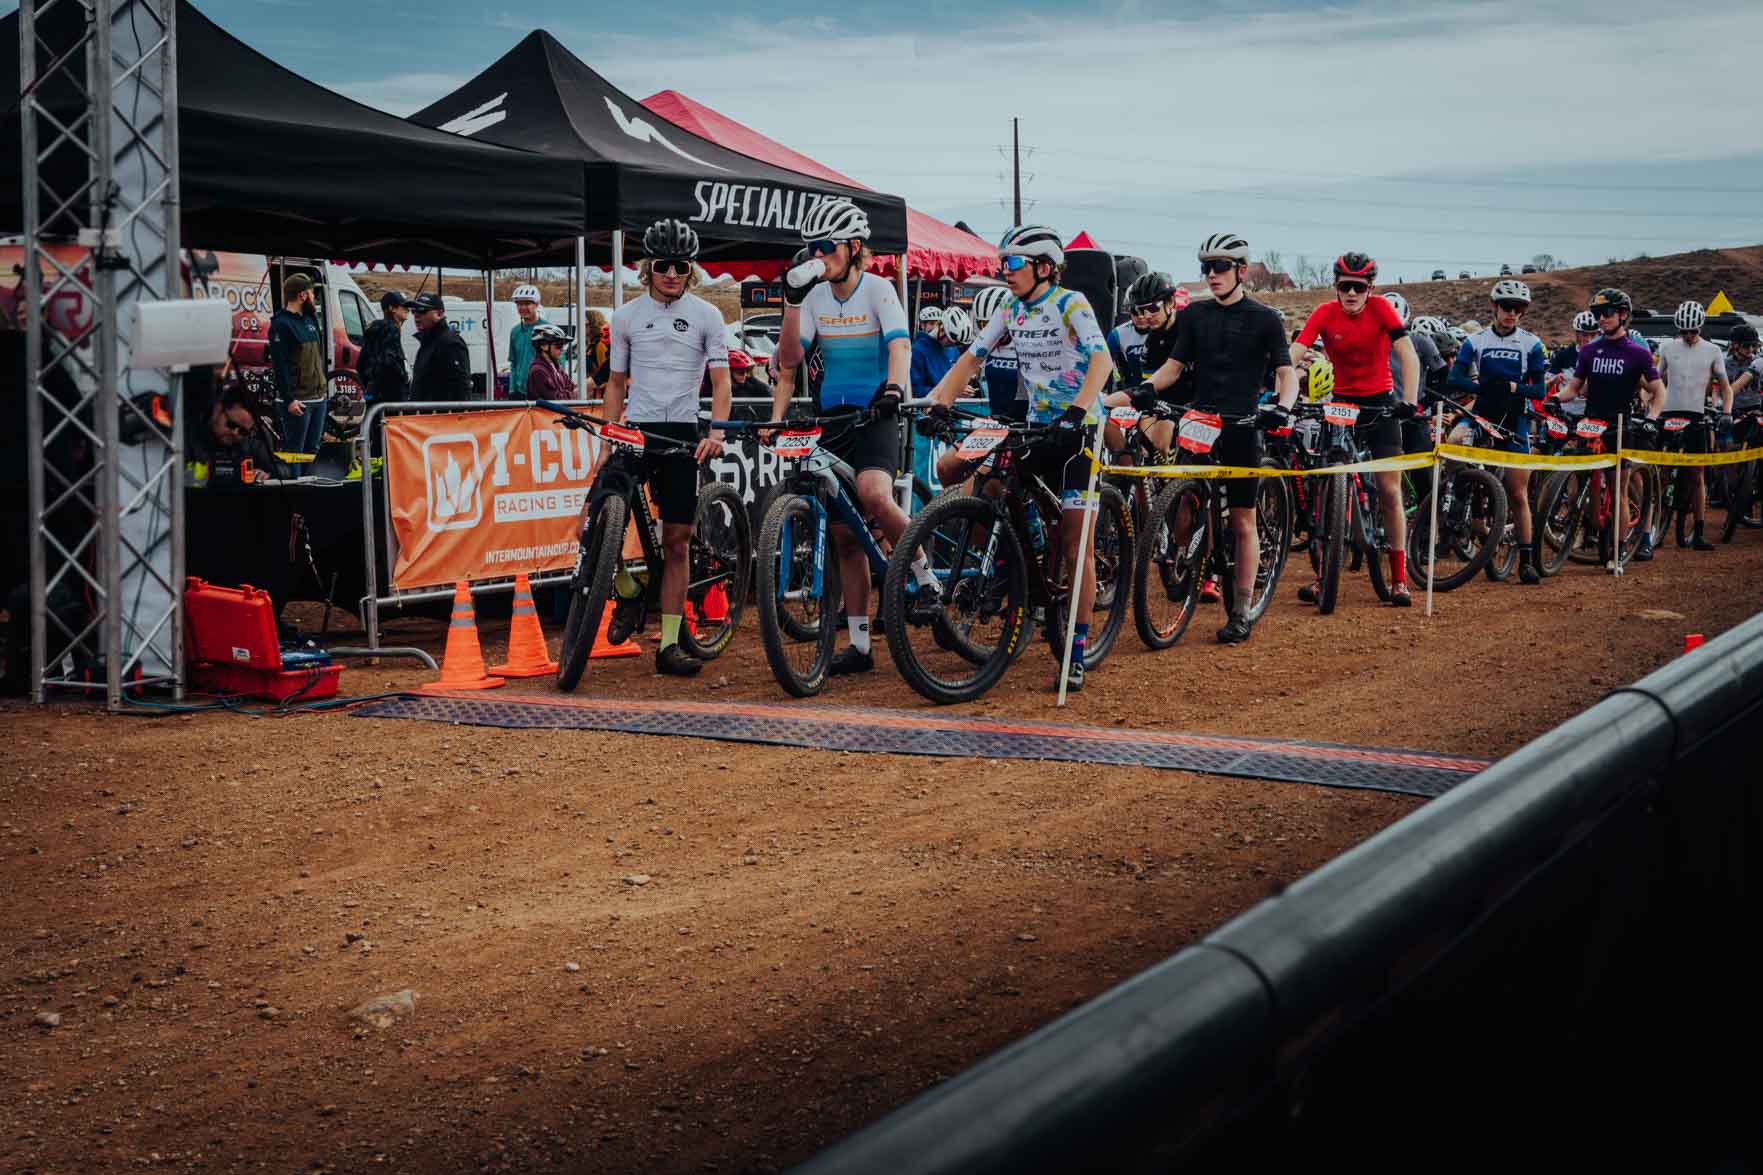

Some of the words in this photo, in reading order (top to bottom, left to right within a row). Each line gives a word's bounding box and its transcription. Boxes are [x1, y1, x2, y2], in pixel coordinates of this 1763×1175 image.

[689, 180, 852, 230] SPECIALIZ
[1011, 328, 1060, 339] TREK
[1482, 350, 1520, 360] ACCEL
[1592, 357, 1625, 375] DHHS
[497, 496, 557, 514] RACING
[563, 493, 588, 511] SE
